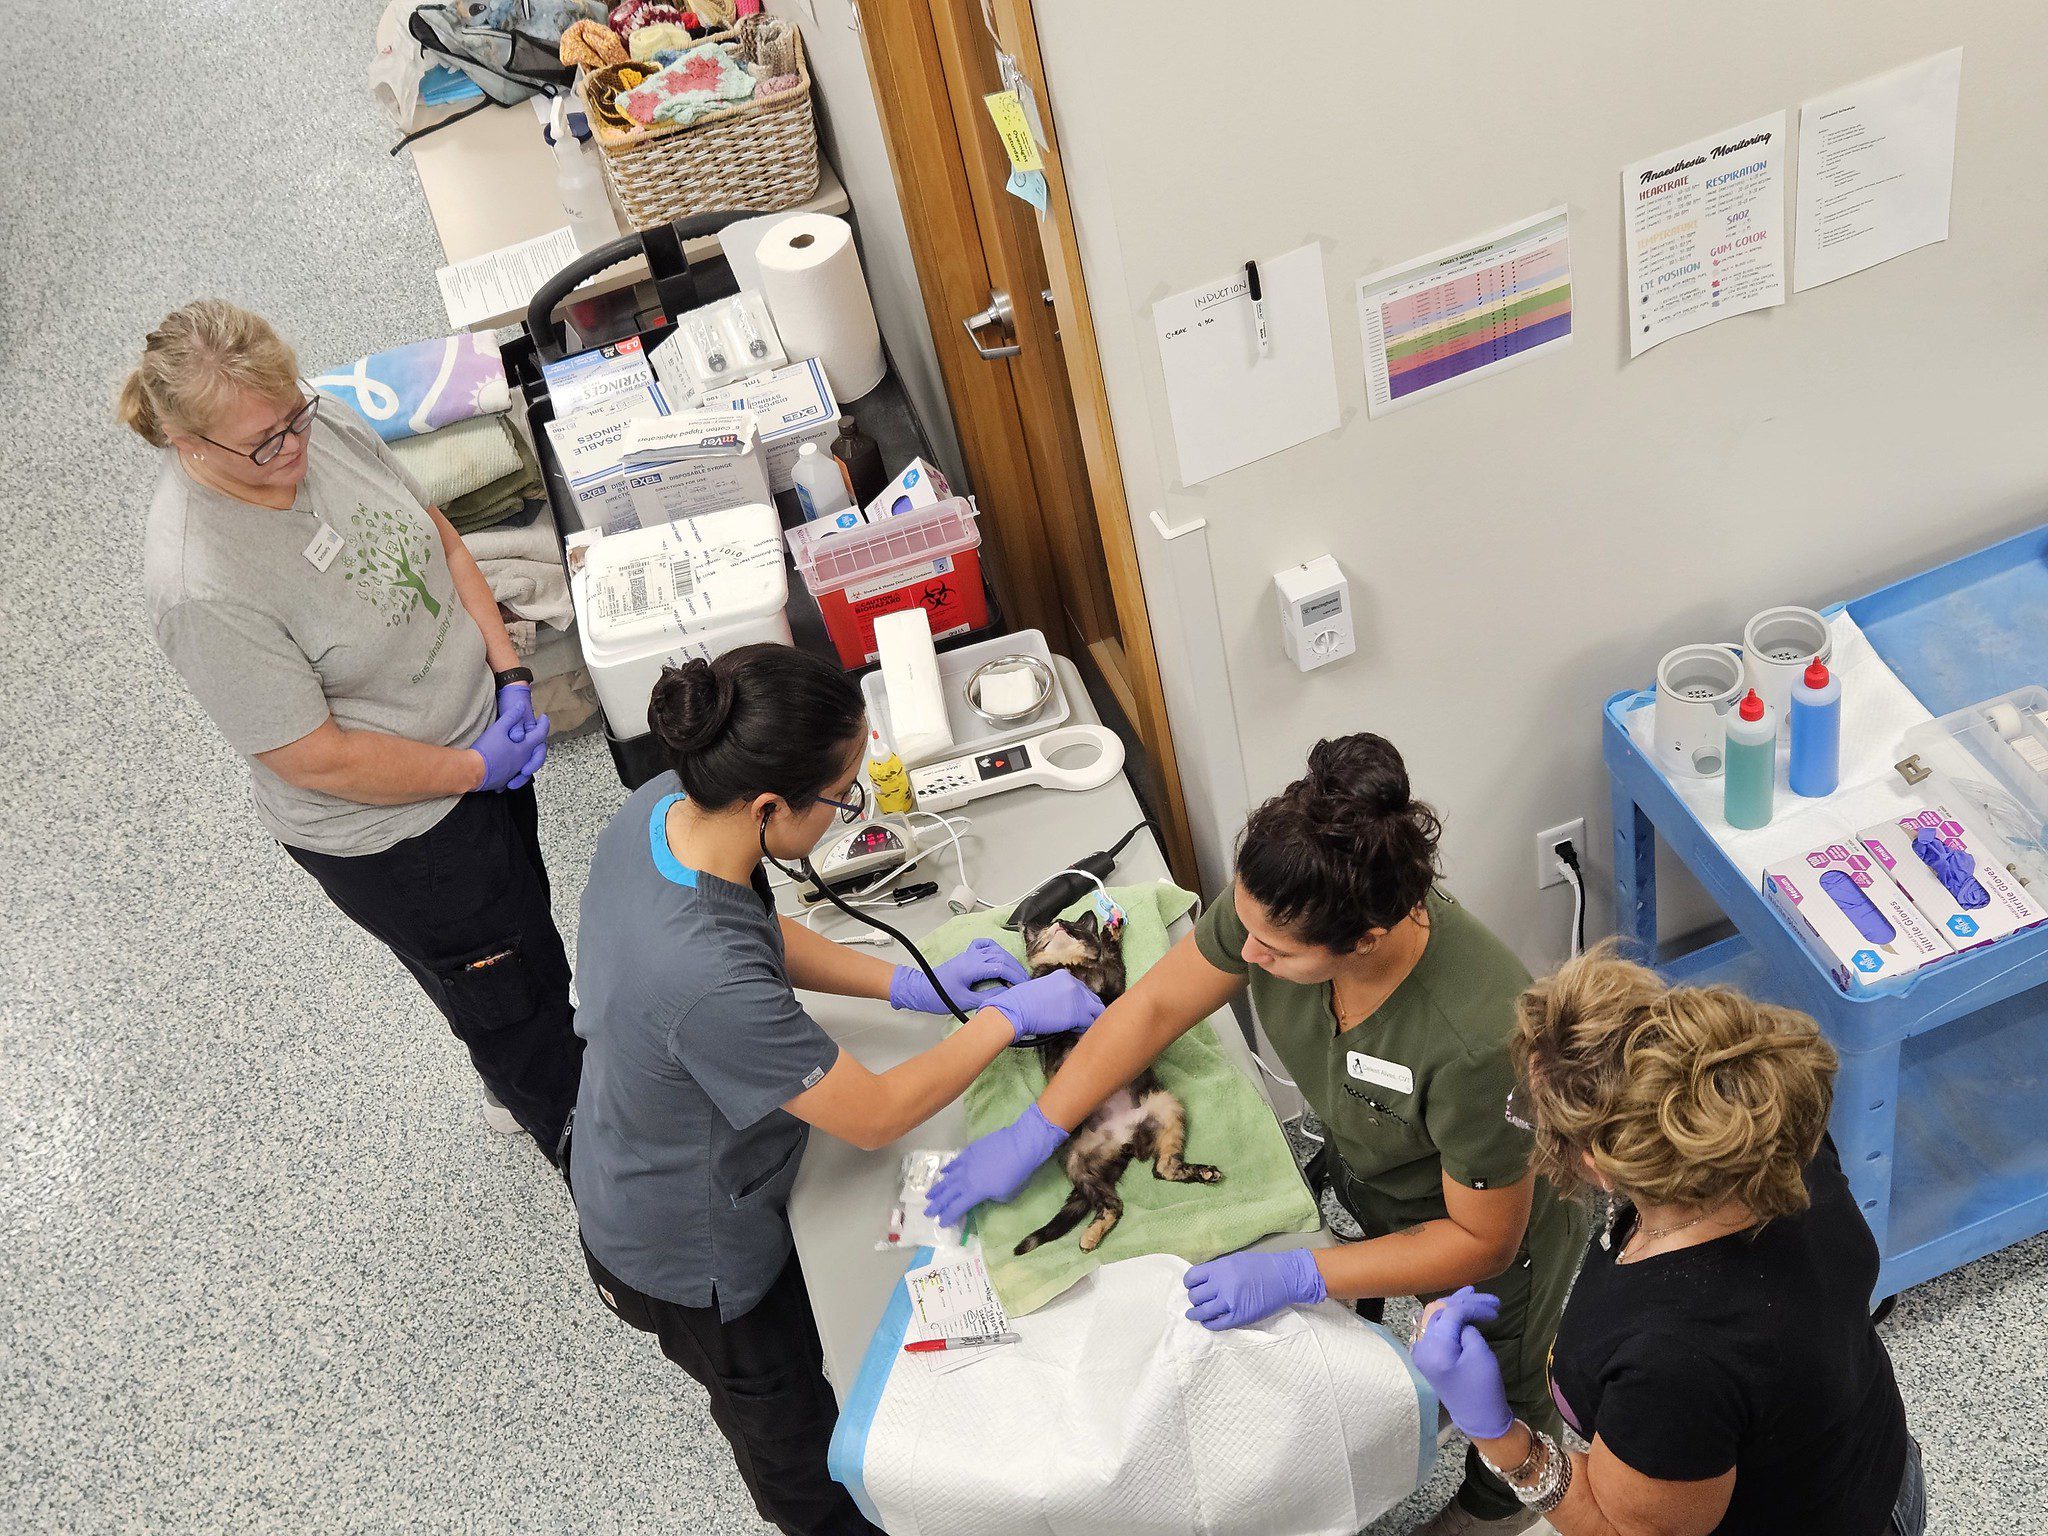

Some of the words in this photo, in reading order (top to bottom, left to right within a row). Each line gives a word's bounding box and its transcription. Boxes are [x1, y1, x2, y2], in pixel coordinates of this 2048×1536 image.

[1006, 132, 1021, 162] Saturday
[1640, 155, 1707, 185] Anaesthesia
[1710, 132, 1772, 160] Monitoring
[1705, 160, 1767, 190] RESPIRATION
[1639, 175, 1689, 201] HEARTRATE
[1637, 220, 1699, 250] TEMPERATURE
[1710, 242, 1732, 257] GUM
[1735, 230, 1767, 248] COLOR
[1439, 256, 1459, 267] ANGEL'S
[1459, 251, 1472, 260] WISH
[1472, 244, 1494, 256] SURGERY
[1640, 279, 1655, 293] EYE
[1658, 261, 1701, 285] POSITION
[1194, 280, 1247, 308] INDUCTION
[583, 370, 648, 400] SYRINGES
[743, 378, 761, 388] 1mL
[750, 393, 781, 407] SYRING
[758, 397, 788, 409] DISPOS
[587, 405, 605, 418] 3mL
[782, 405, 818, 423] EXEL
[637, 432, 679, 442] Applicators
[679, 428, 704, 437] Tipped
[767, 440, 802, 453] DISPOSABLE
[800, 431, 828, 443] SYRINGES
[573, 433, 622, 456] OSABLE
[631, 474, 661, 488] EXEL
[669, 469, 706, 481] DISPOSABLE
[706, 462, 733, 472] SYRINGE
[580, 486, 606, 501] EXEL
[655, 482, 685, 492] DIRECTIONS
[855, 597, 901, 614] BIOHAZARD
[860, 595, 895, 608] CAUTION
[411, 617, 453, 684] Sustainability
[1874, 845, 1891, 861] Small
[1780, 878, 1800, 899] Medium
[1983, 866, 2008, 892] Gloves
[1889, 901, 1914, 926] Gloves
[2006, 890, 2032, 918] Nitrile
[1912, 923, 1937, 952] Nitrile
